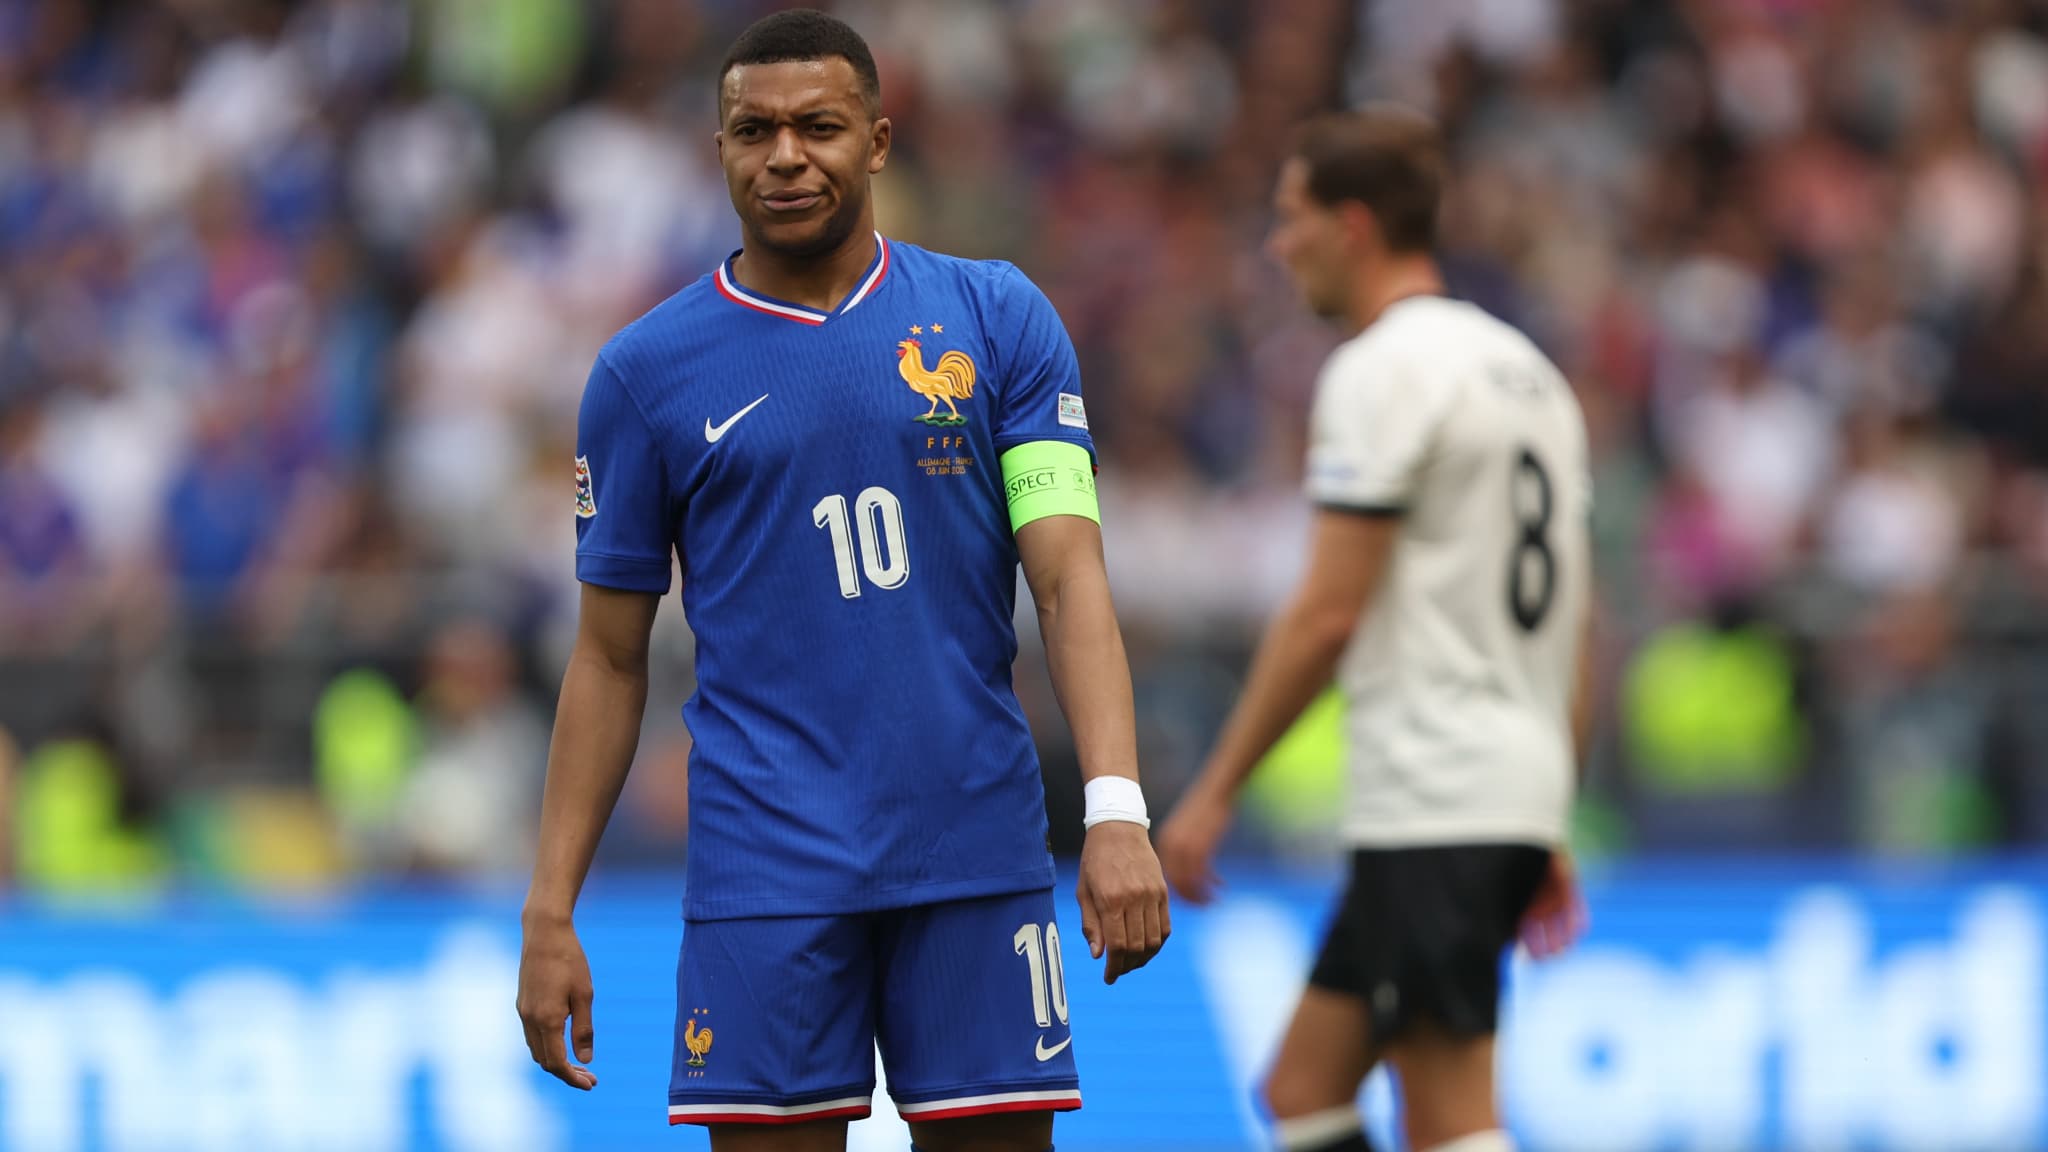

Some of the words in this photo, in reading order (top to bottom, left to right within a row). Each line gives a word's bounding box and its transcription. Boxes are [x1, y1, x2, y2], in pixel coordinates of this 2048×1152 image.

[812, 486, 910, 599] 10
[1508, 445, 1556, 635] 8
[1013, 921, 1069, 1028] 10
